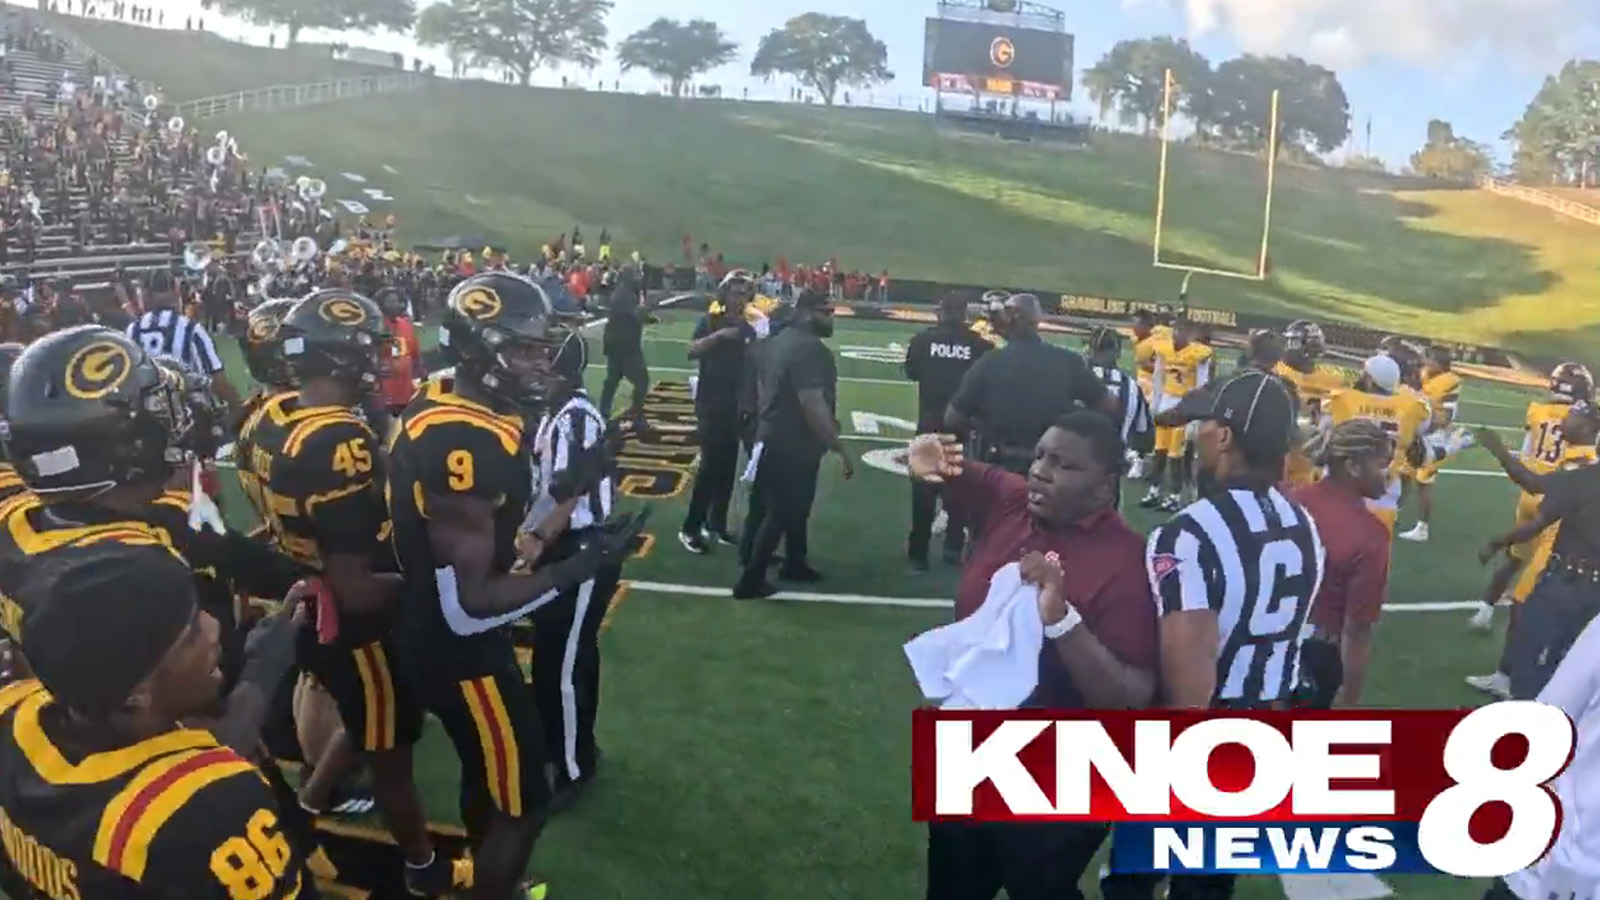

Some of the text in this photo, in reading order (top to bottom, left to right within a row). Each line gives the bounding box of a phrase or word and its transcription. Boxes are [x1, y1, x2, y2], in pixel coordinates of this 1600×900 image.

[930, 343, 971, 360] POLICE
[332, 438, 372, 478] 45
[446, 450, 475, 491] 9
[1249, 538, 1304, 636] C
[209, 808, 292, 900] 86
